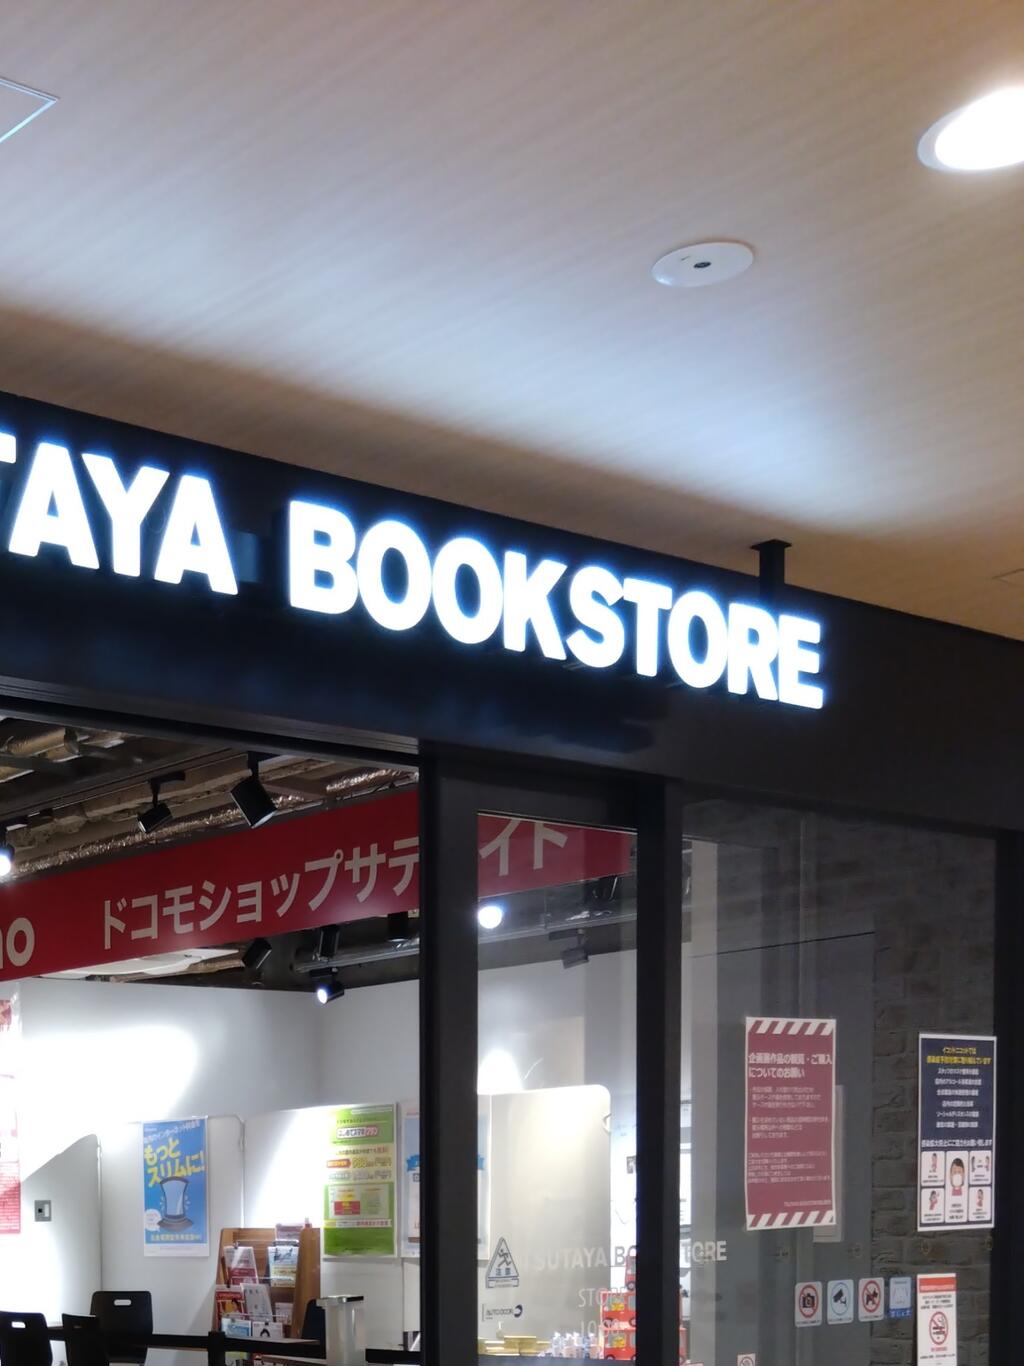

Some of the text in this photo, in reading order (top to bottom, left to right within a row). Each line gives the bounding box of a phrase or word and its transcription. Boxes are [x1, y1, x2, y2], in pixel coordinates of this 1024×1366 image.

[288, 500, 824, 710] BOOKSTORE
[103, 819, 568, 950] ドコモショップサテイト
[522, 1246, 608, 1271] SUTAYA
